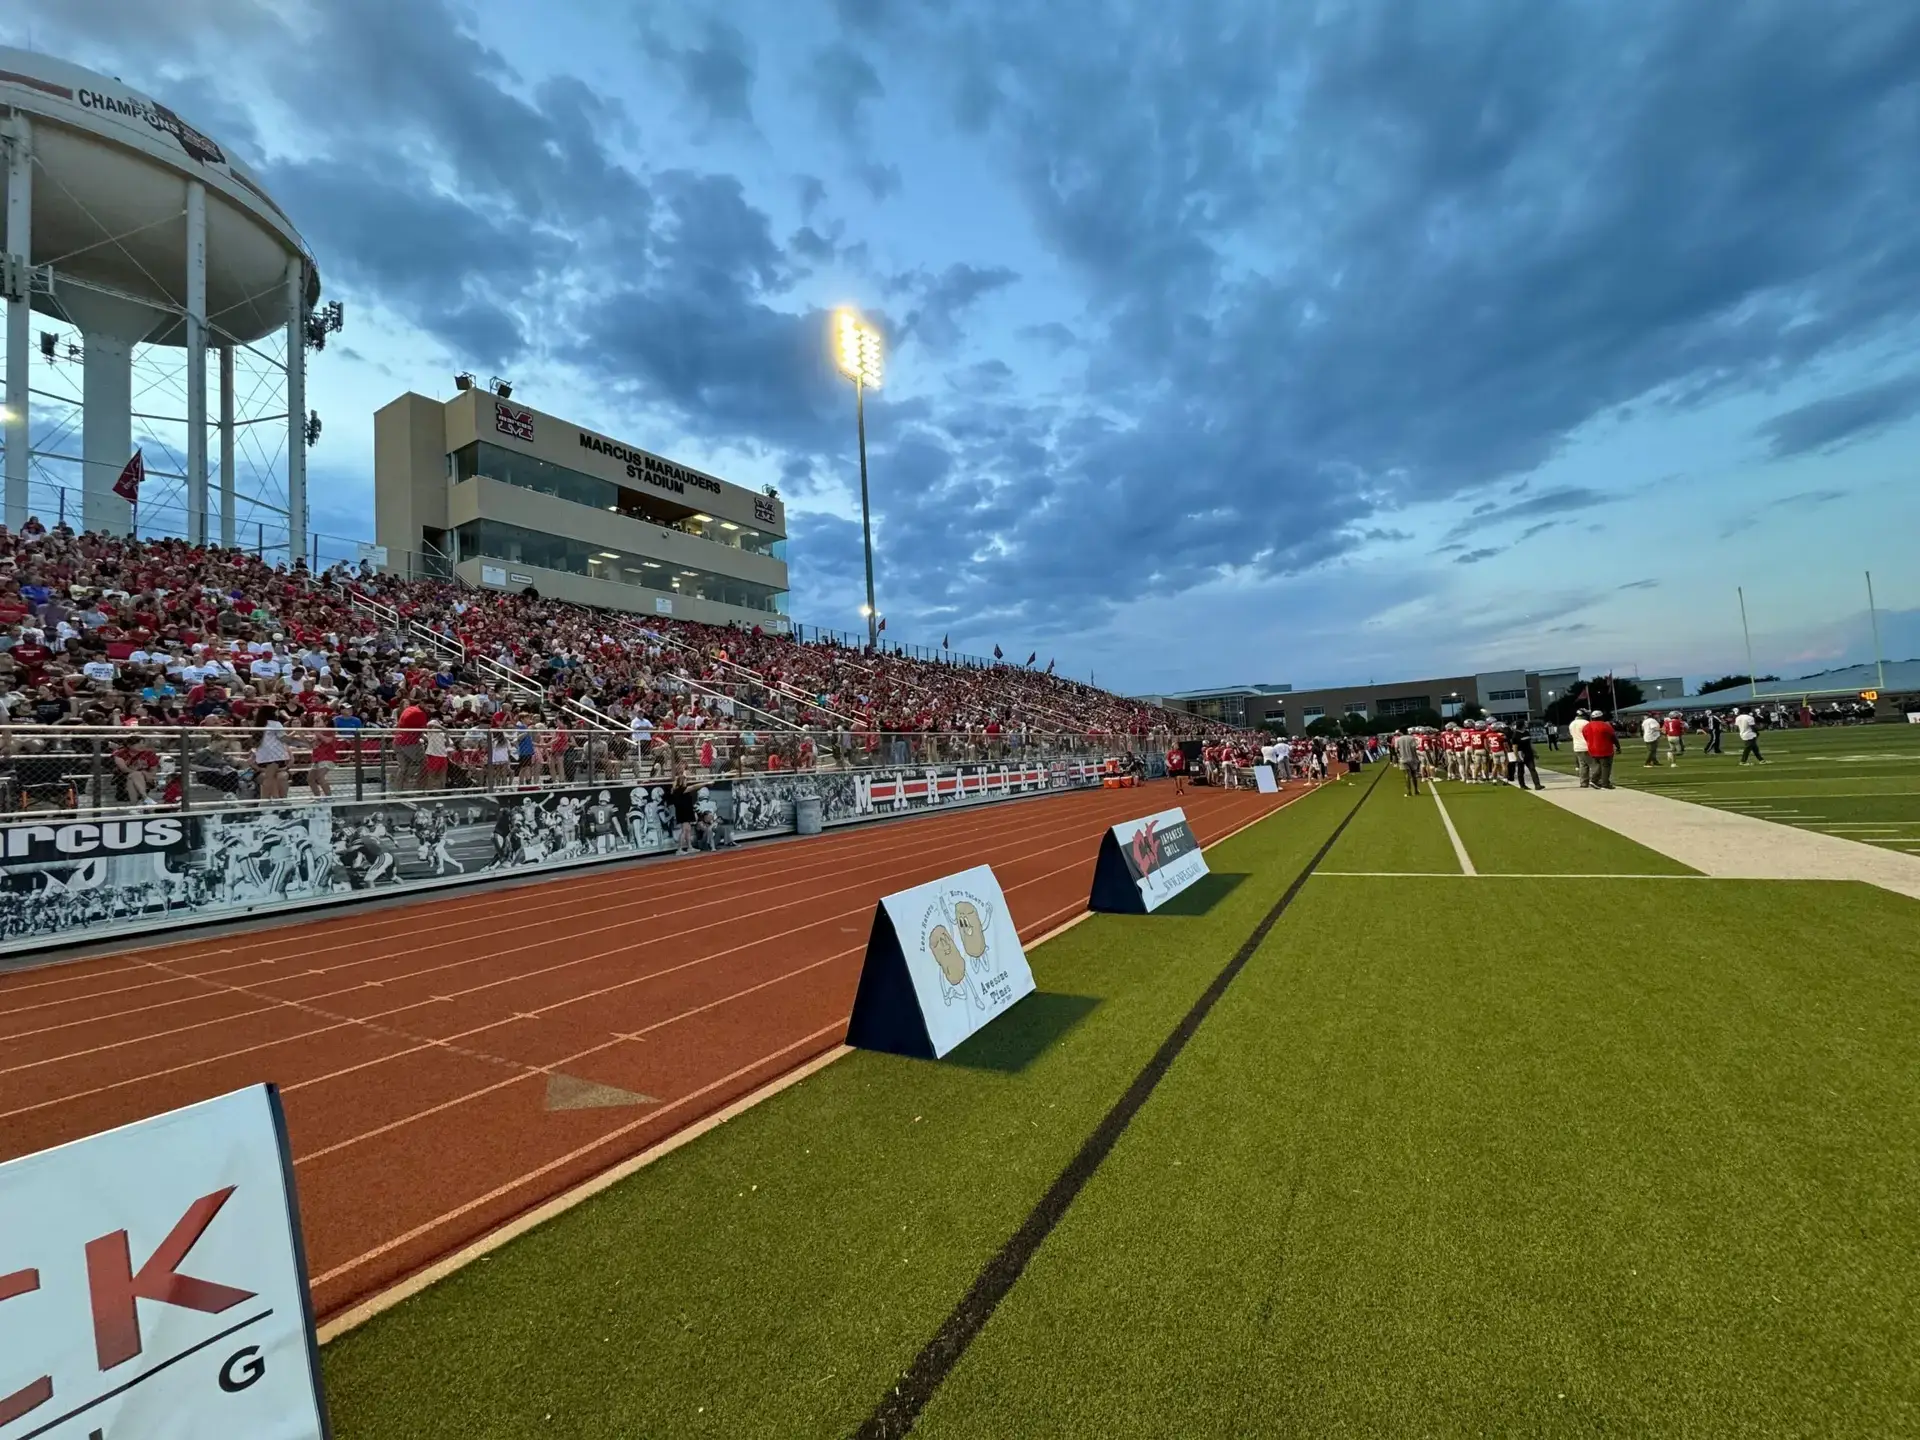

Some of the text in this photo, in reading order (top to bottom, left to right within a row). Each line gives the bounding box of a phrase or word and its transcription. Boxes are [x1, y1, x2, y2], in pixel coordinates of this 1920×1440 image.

[78, 89, 180, 135] CHAMPIONS
[579, 432, 721, 495] MARCUS MARAUDERS
[626, 465, 684, 495] STADIUM
[1861, 691, 1878, 700] 40
[0, 818, 183, 858] rcus
[1160, 826, 1185, 846] JAPANESE
[1163, 842, 1180, 857] GRILL
